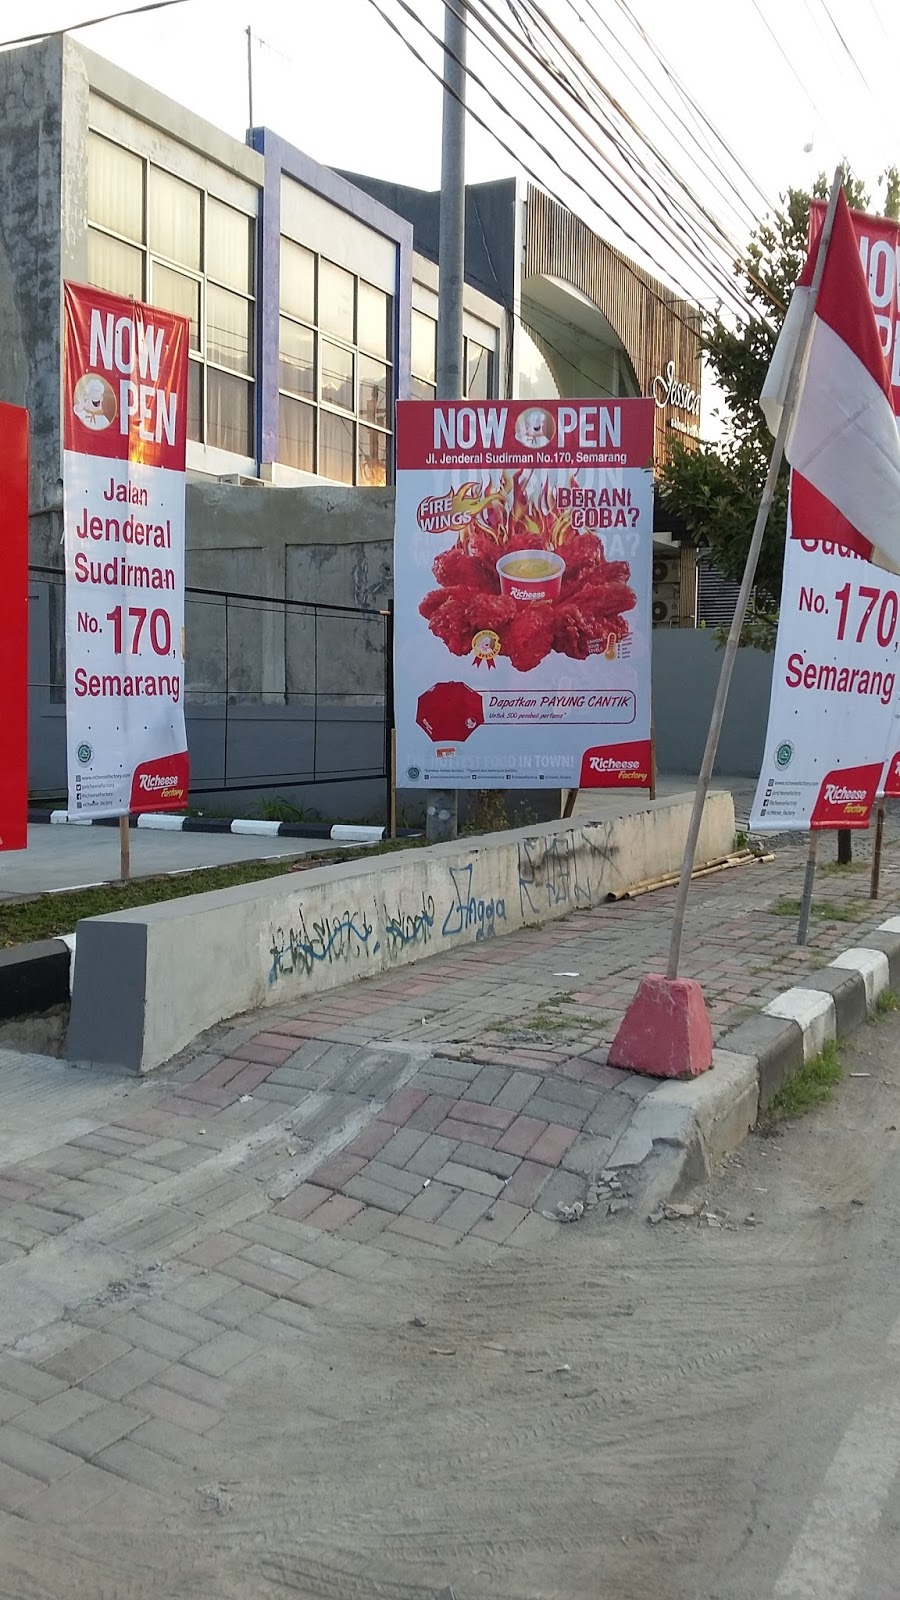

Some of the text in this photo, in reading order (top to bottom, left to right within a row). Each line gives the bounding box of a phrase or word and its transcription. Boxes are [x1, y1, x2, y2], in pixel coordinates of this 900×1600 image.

[89, 308, 165, 382] NOW
[653, 360, 701, 416] Jessica
[433, 407, 508, 449] NOW
[425, 451, 627, 465] Jl. Jenderal Sudirman No.170, Semarang
[103, 477, 148, 506] Jalan
[557, 487, 632, 508] BERANI
[420, 498, 453, 516] FIRE
[571, 507, 640, 529] COBA?
[76, 508, 171, 549] Jenderal
[420, 510, 472, 532] WINGS
[74, 552, 175, 590] Sudirman
[510, 586, 546, 600] Richeese
[798, 582, 899, 652] No. 170,
[77, 605, 177, 659] No. 170,
[74, 667, 180, 703] Semarang
[785, 653, 896, 705] Semarang
[489, 696, 632, 709] Dapatkan PAYUNG CANTIK
[589, 756, 640, 772] Richeese
[139, 774, 179, 791] Richeese
[618, 770, 647, 782] Factory
[161, 788, 184, 799] Factory
[823, 784, 867, 805] Richeese
[843, 802, 868, 816] Factory
